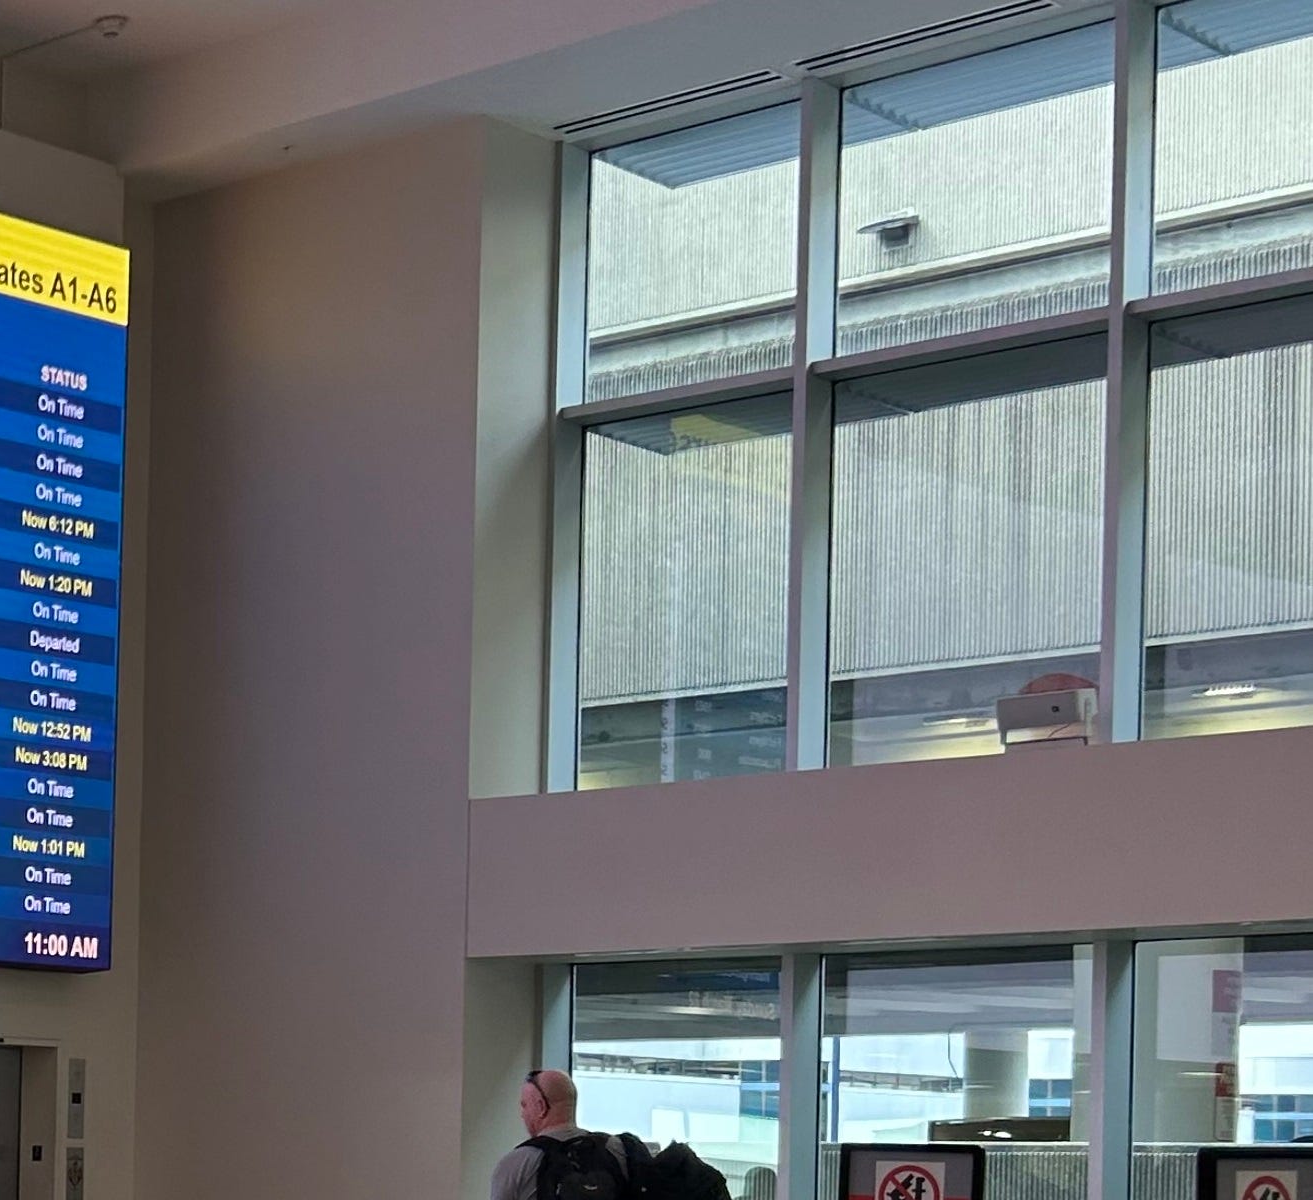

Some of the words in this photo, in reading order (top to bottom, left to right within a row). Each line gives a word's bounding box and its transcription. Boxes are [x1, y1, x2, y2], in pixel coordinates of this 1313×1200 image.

[50, 272, 117, 314] A1-A6
[41, 365, 88, 392] STATUS
[38, 394, 56, 414] On
[57, 398, 85, 420] Time
[22, 509, 48, 530] Now
[48, 515, 74, 536] 6:12
[74, 520, 95, 539] PM
[20, 569, 46, 589] Now
[48, 574, 72, 594] 1:20
[73, 578, 93, 598] PM
[32, 601, 51, 619] On
[51, 604, 79, 625] Time
[30, 630, 81, 654] Departed
[13, 716, 39, 735] Now
[40, 721, 71, 741] 12:52
[72, 725, 92, 743] PM
[15, 746, 42, 765] Now
[42, 750, 67, 769] 3:08
[68, 753, 88, 771] PM
[12, 835, 39, 853] Now
[40, 838, 64, 856] 1:01
[66, 841, 86, 858] PM
[24, 932, 68, 957] 11:00
[70, 936, 99, 959] AM
